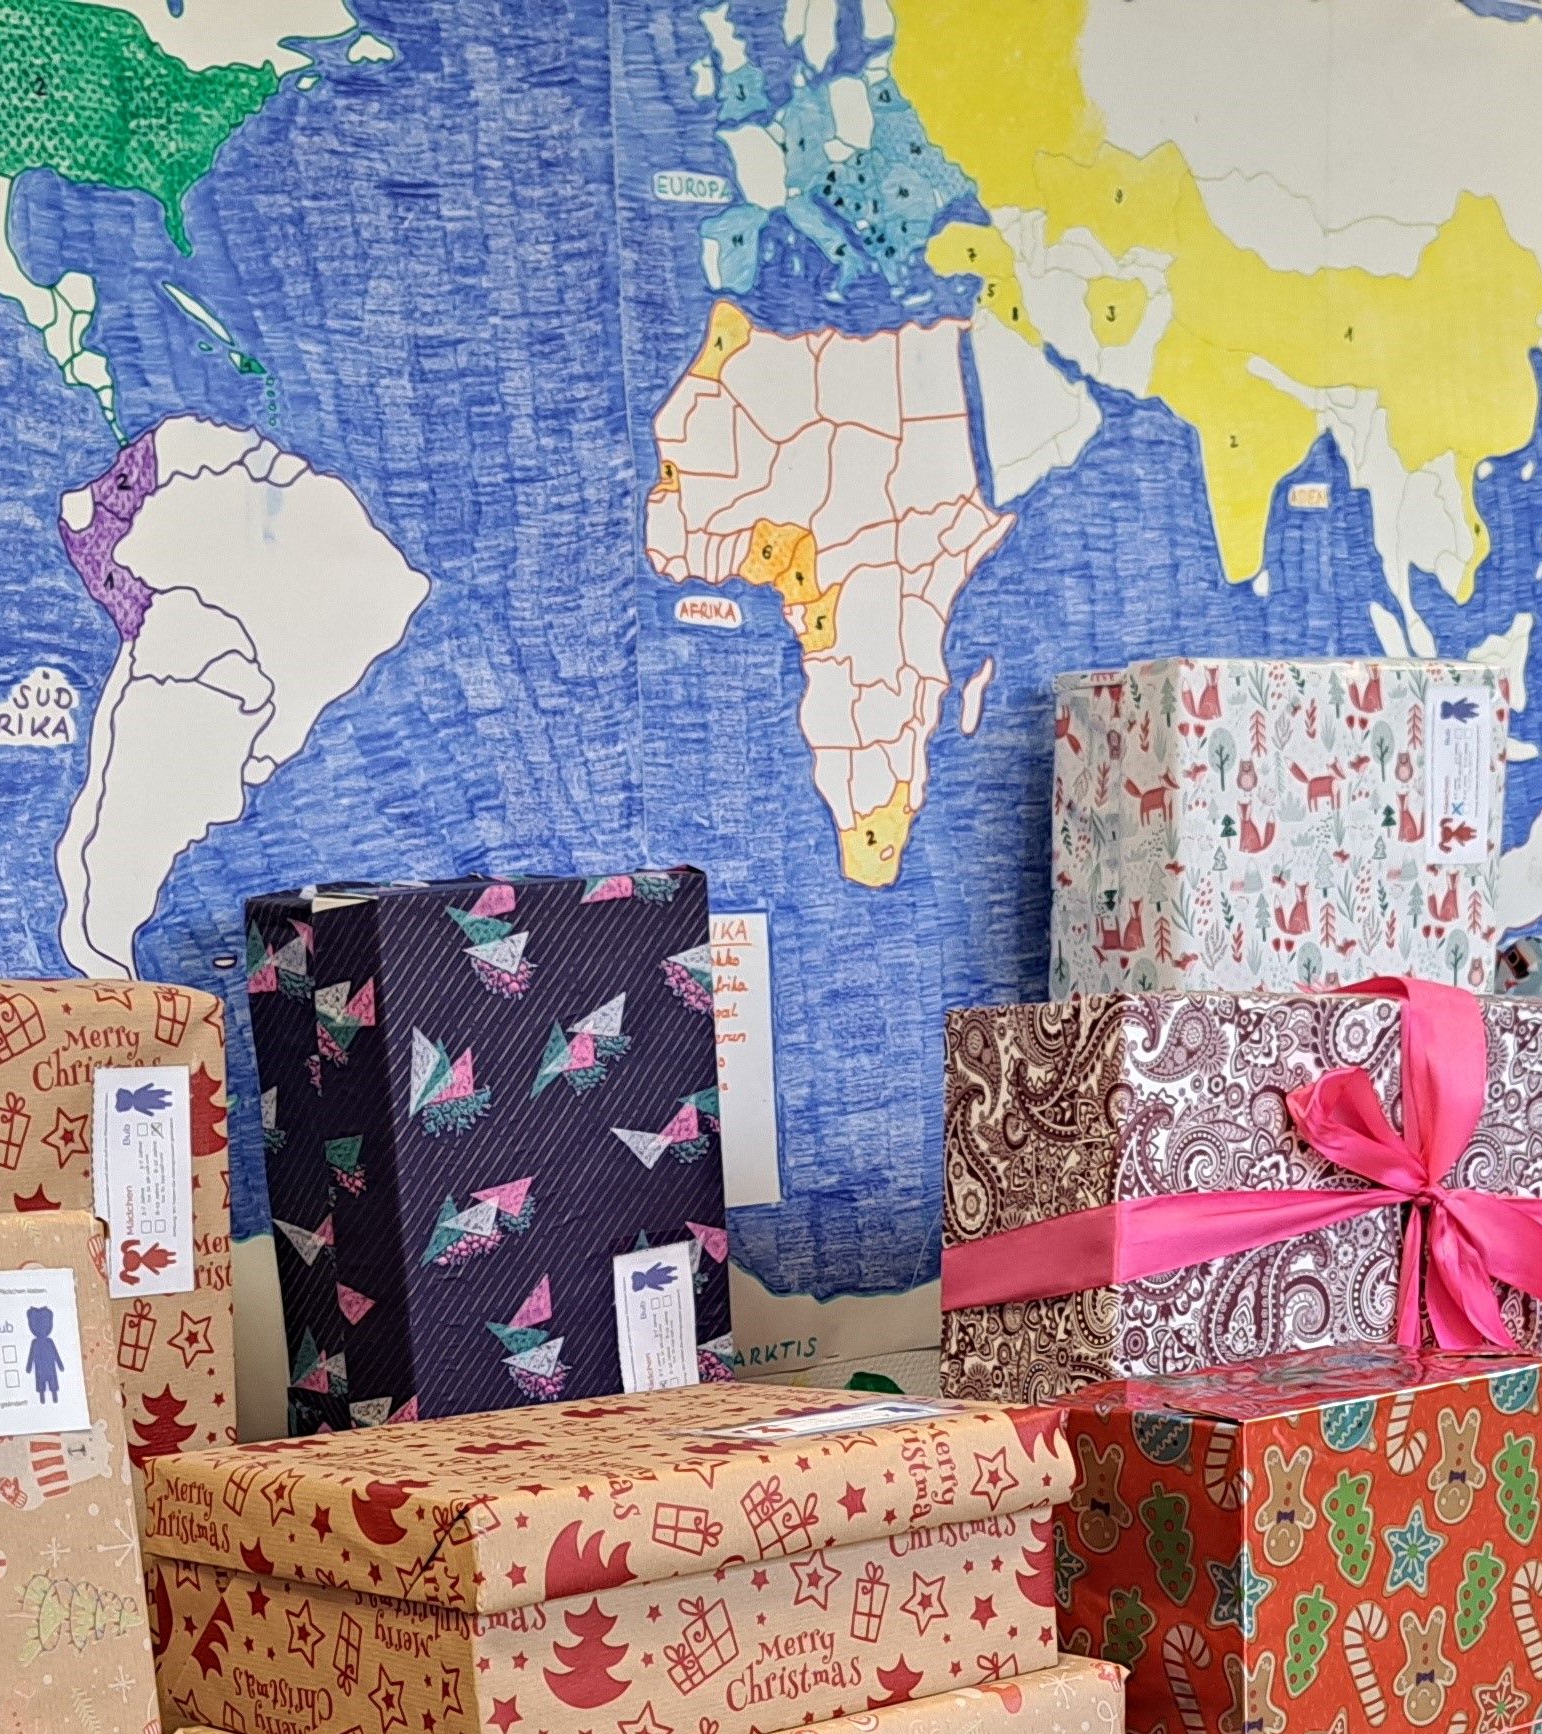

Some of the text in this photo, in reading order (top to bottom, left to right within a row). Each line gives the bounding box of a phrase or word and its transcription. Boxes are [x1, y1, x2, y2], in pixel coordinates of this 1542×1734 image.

[35, 77, 47, 95] 2
[658, 175, 732, 199] EUROPA
[987, 283, 996, 298] 5
[1106, 306, 1115, 322] 3
[1345, 326, 1354, 341] 1
[715, 337, 724, 351] 1
[1229, 435, 1238, 448] 2
[116, 474, 132, 490] 2
[762, 545, 773, 560] 6
[104, 572, 114, 590] 1
[679, 600, 737, 621] AFRIKA
[815, 615, 826, 631] 5
[12, 670, 73, 710] SÜD
[866, 831, 877, 846] 2
[62, 1025, 140, 1059] Merry
[164, 1477, 214, 1521] Merry
[145, 1496, 231, 1554] Christmas
[374, 1607, 433, 1659] Merry
[755, 1628, 836, 1665] Merry
[725, 1655, 862, 1712] Christmas
[232, 1666, 334, 1731] Christmas
